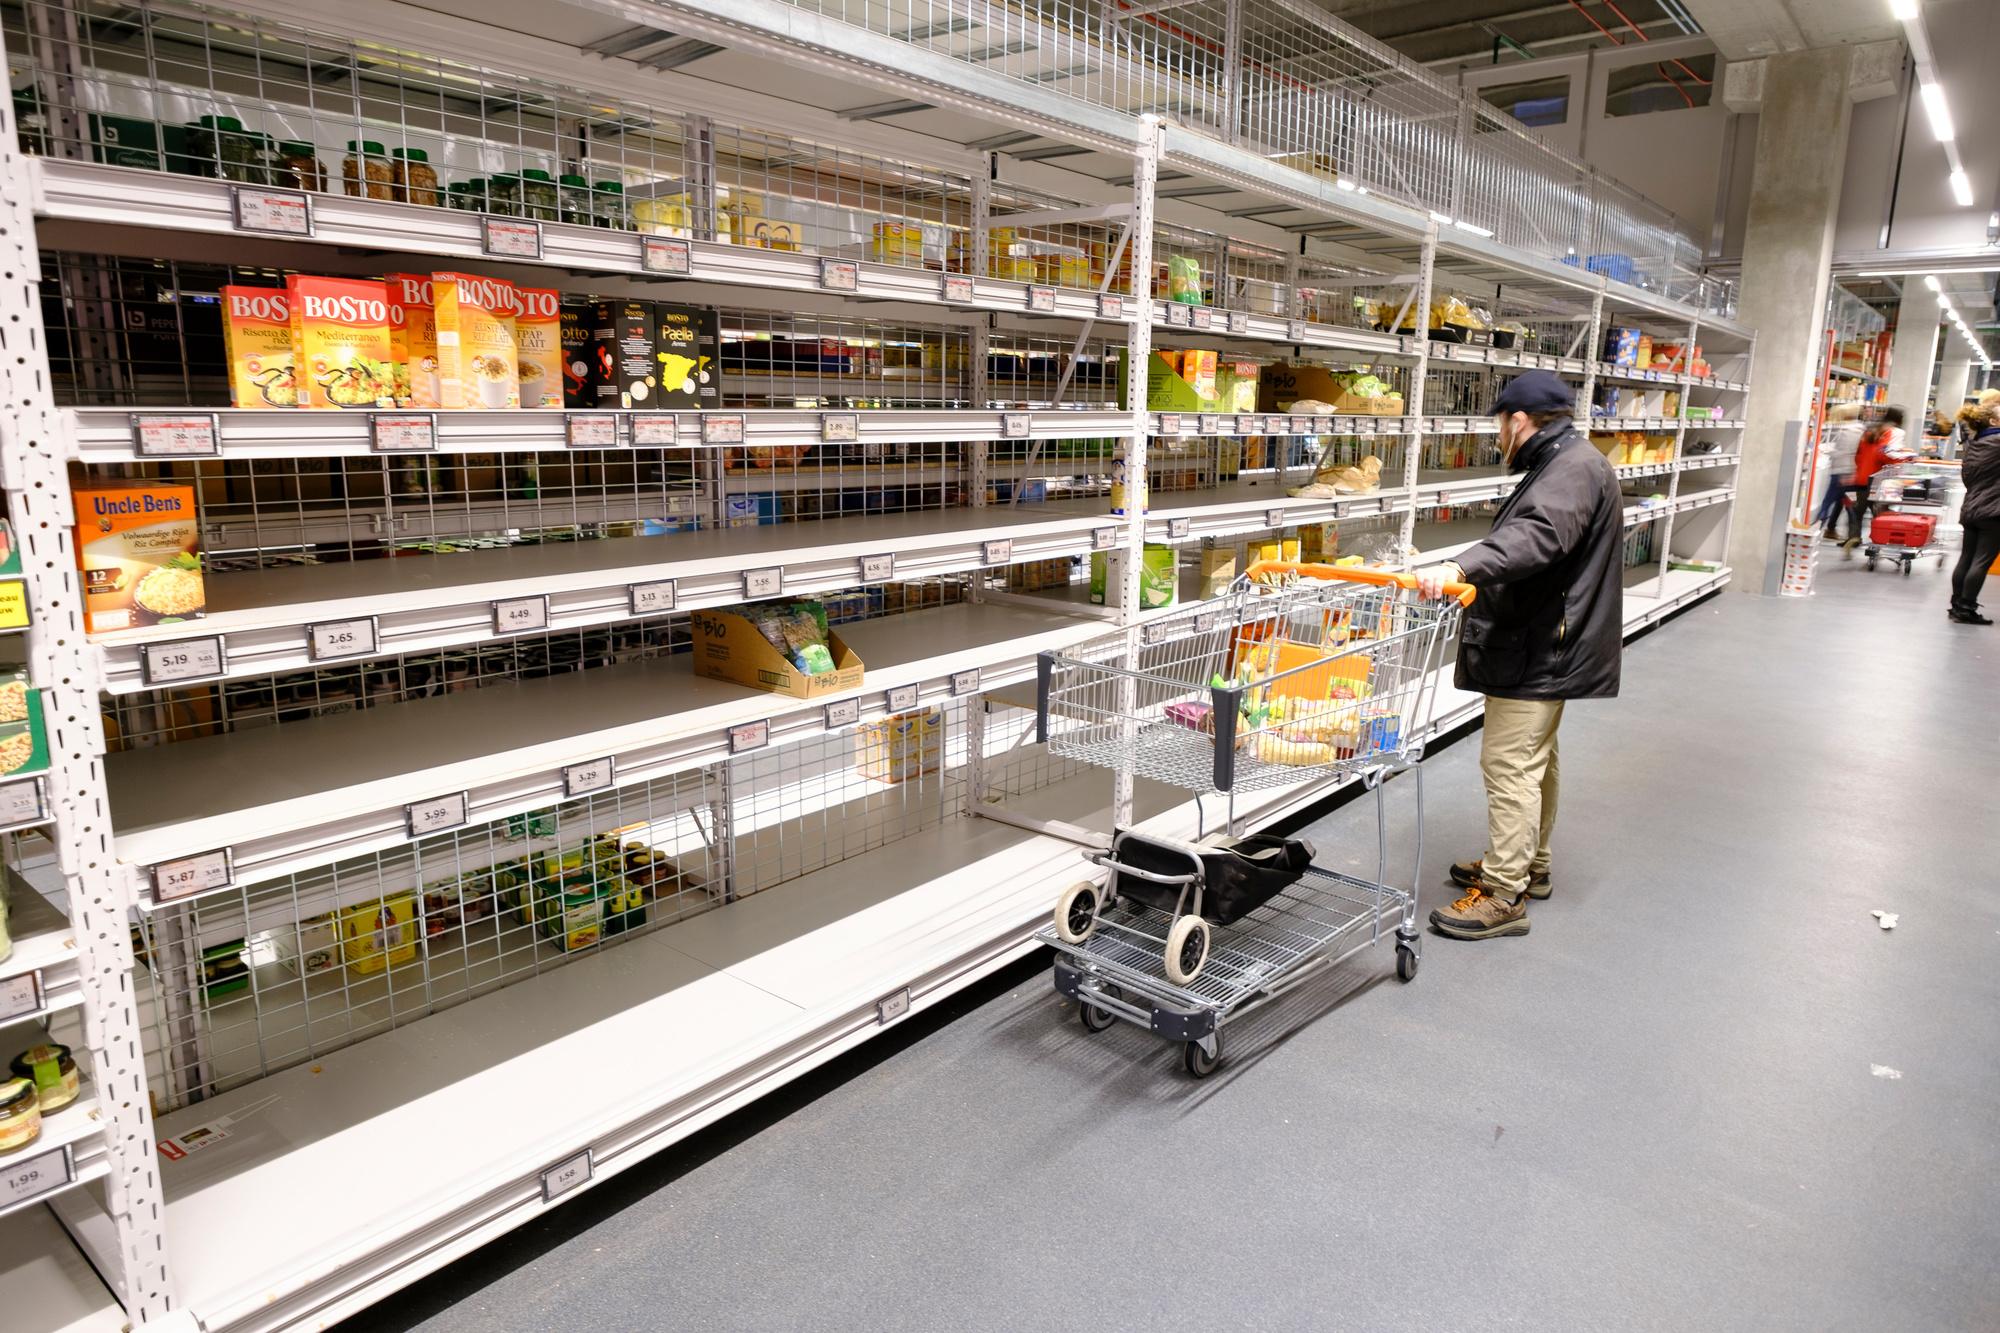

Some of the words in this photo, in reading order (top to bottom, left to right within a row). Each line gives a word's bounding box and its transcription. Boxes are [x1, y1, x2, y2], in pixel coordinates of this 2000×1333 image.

[401, 279, 434, 305] BO
[457, 278, 515, 311] BOSTO
[231, 295, 290, 322] BOS
[303, 295, 386, 323] BOSTO
[513, 289, 558, 317] STO
[242, 327, 278, 338] Risotto
[662, 325, 694, 342] Paella
[93, 495, 141, 515] Uncle
[143, 494, 182, 512] Ben's
[121, 528, 170, 540] Volwaardige
[134, 540, 147, 548] Riz
[149, 537, 181, 549] Complet
[91, 571, 106, 581] 12
